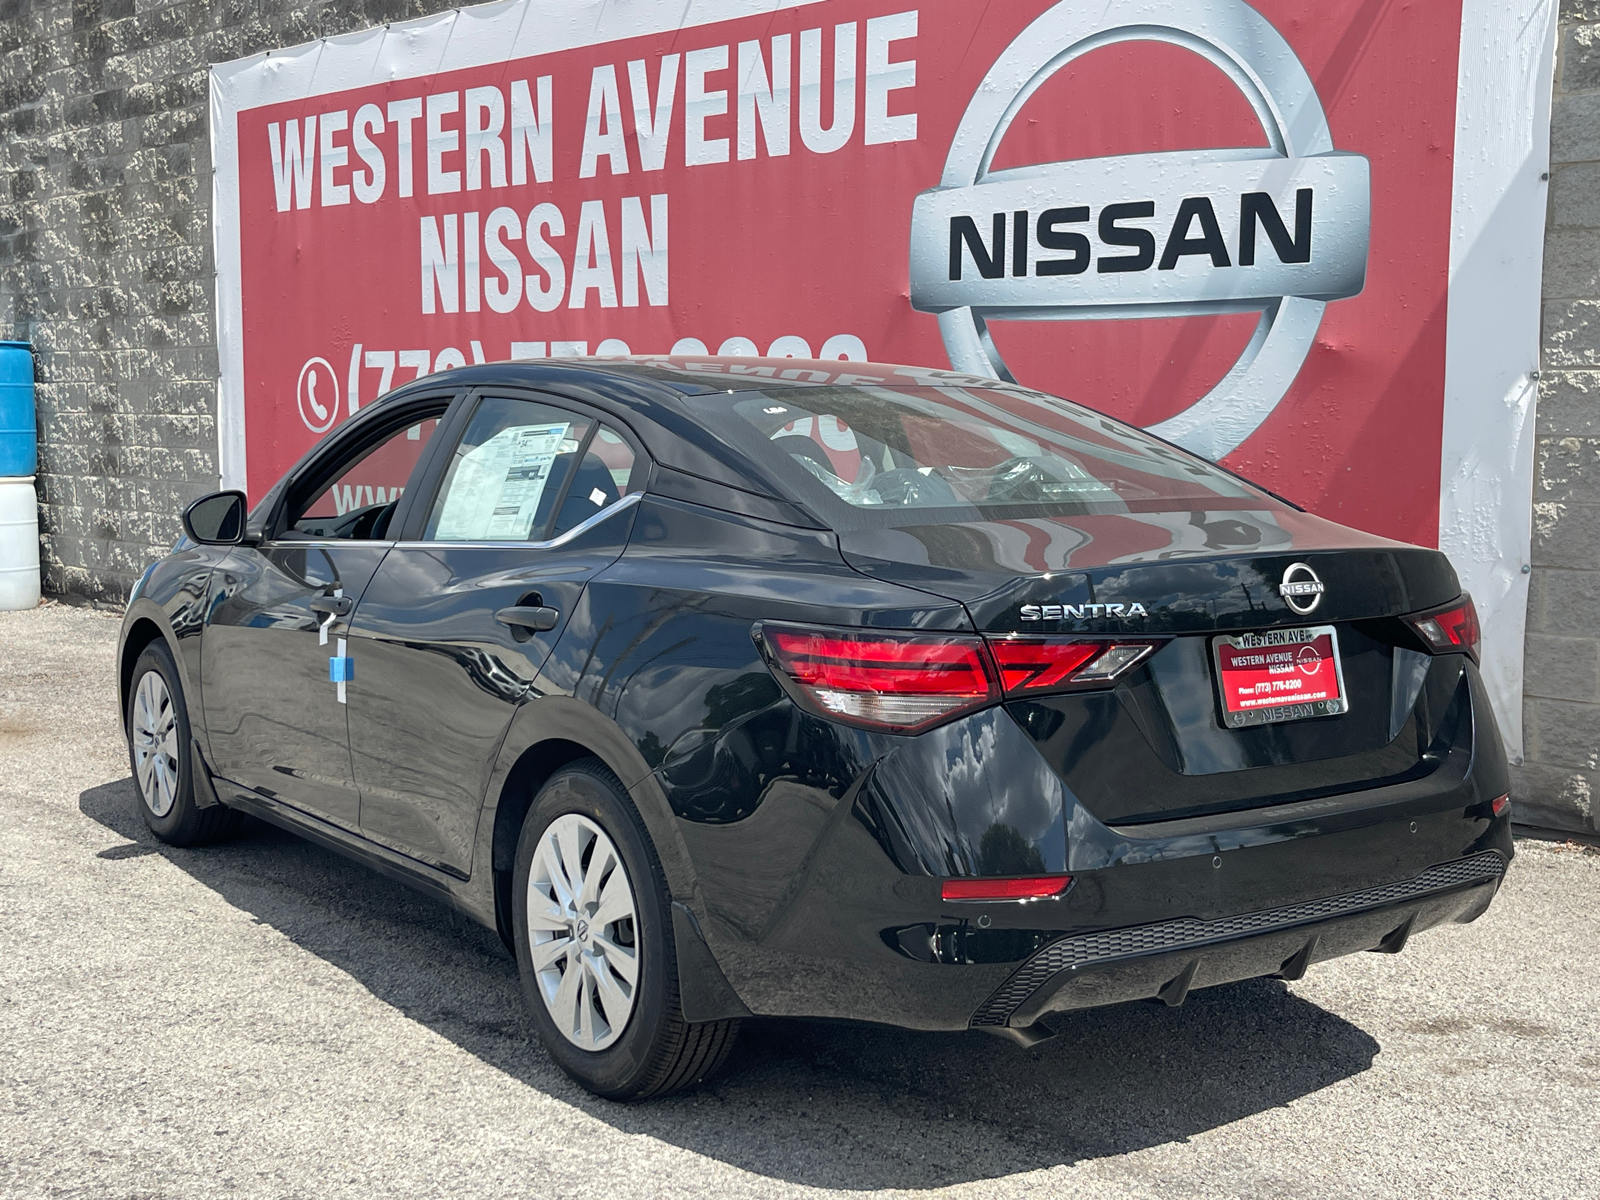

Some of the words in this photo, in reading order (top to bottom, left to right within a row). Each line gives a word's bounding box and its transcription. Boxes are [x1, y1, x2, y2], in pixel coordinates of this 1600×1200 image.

[267, 74, 554, 213] WESTERN
[578, 9, 919, 180] AVENUE
[949, 187, 1314, 281] NISSAN
[418, 193, 670, 316] NISSAN
[1281, 583, 1324, 595] NISSAN
[1020, 603, 1148, 621] SENTRA
[1242, 631, 1286, 648] WESTERN
[1287, 629, 1305, 643] AVE
[1231, 655, 1264, 666] WESTERN
[1266, 652, 1292, 663] AVENUE
[1269, 664, 1294, 674] NISSAN
[1255, 682, 1271, 694] (773)
[1240, 692, 1326, 706] www.westernavenissan.com
[1263, 703, 1313, 722] NISSAN
